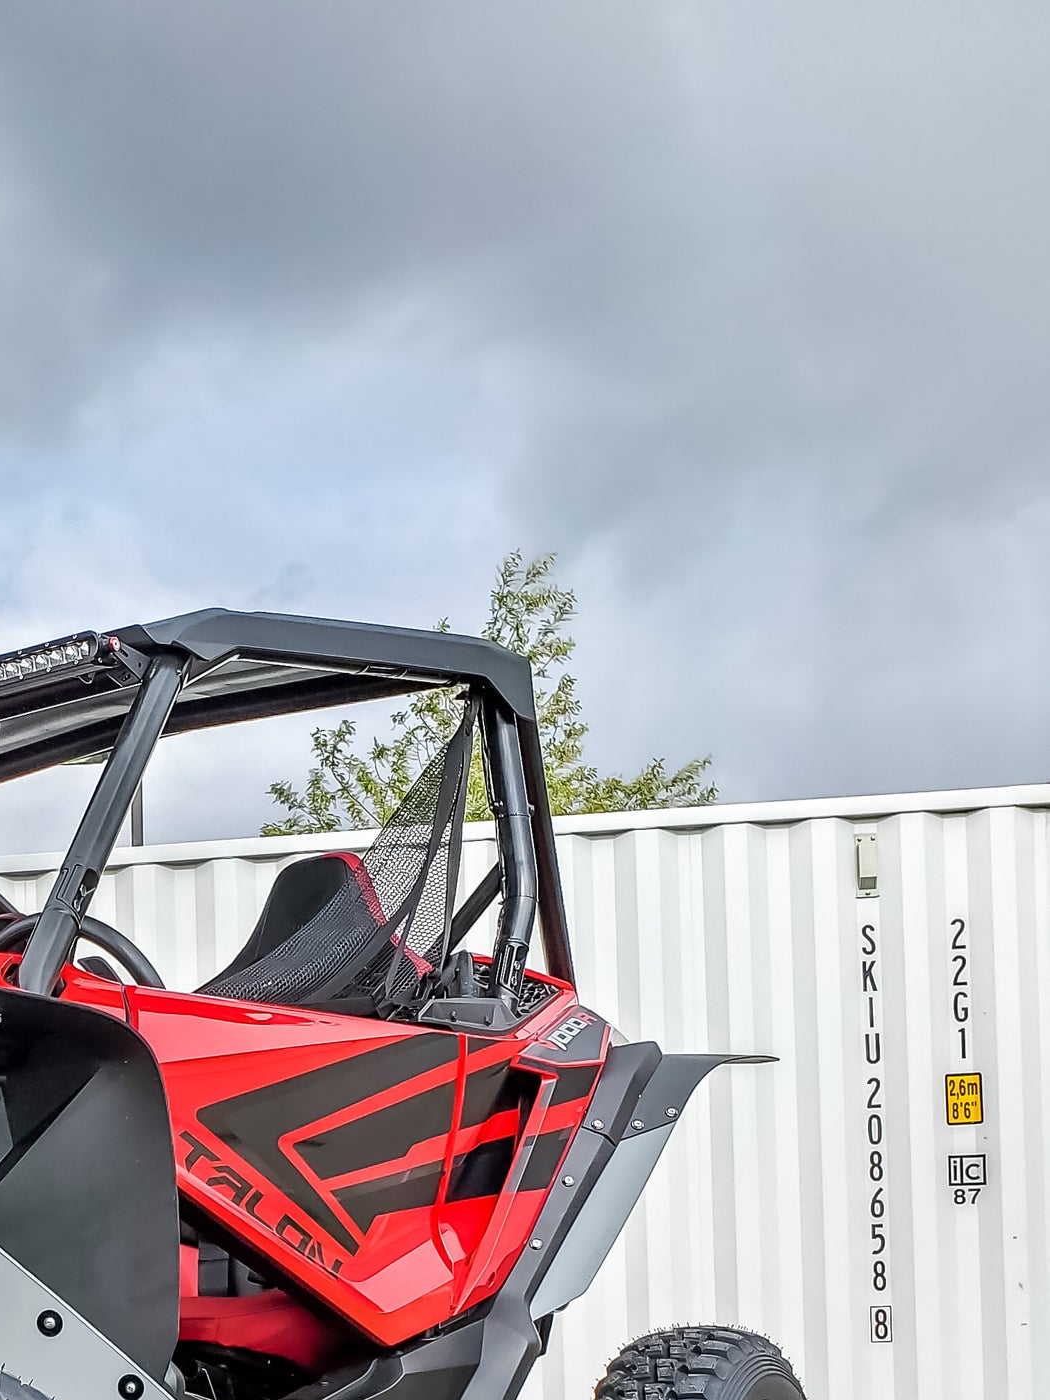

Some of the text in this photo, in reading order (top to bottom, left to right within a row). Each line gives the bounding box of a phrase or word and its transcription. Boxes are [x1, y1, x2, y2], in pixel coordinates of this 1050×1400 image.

[950, 919, 968, 1059] 22G1
[546, 1012, 598, 1051] 1000R
[949, 1079, 978, 1100] 2,6m
[952, 1101, 977, 1119] 8'6"
[861, 924, 888, 1340] SKIU 208658 8
[179, 1130, 344, 1280] TALON
[953, 1188, 981, 1205] 87
